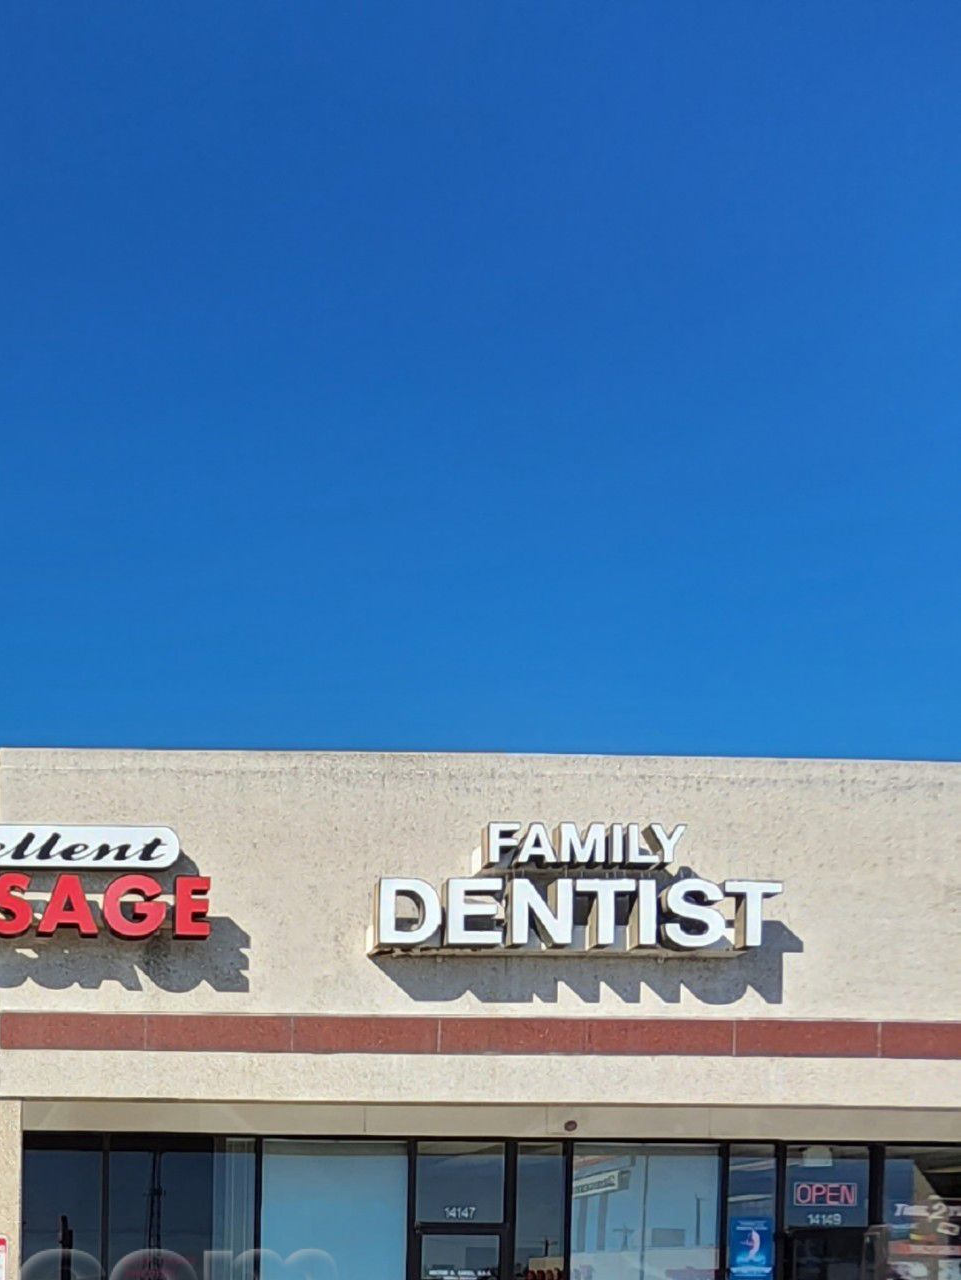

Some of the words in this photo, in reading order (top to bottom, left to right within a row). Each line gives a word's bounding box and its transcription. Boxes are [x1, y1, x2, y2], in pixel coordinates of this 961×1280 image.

[484, 821, 688, 866] FAMILY
[377, 877, 784, 948] DENTIST
[796, 1183, 856, 1204] OPEN
[444, 1206, 476, 1219] 14147
